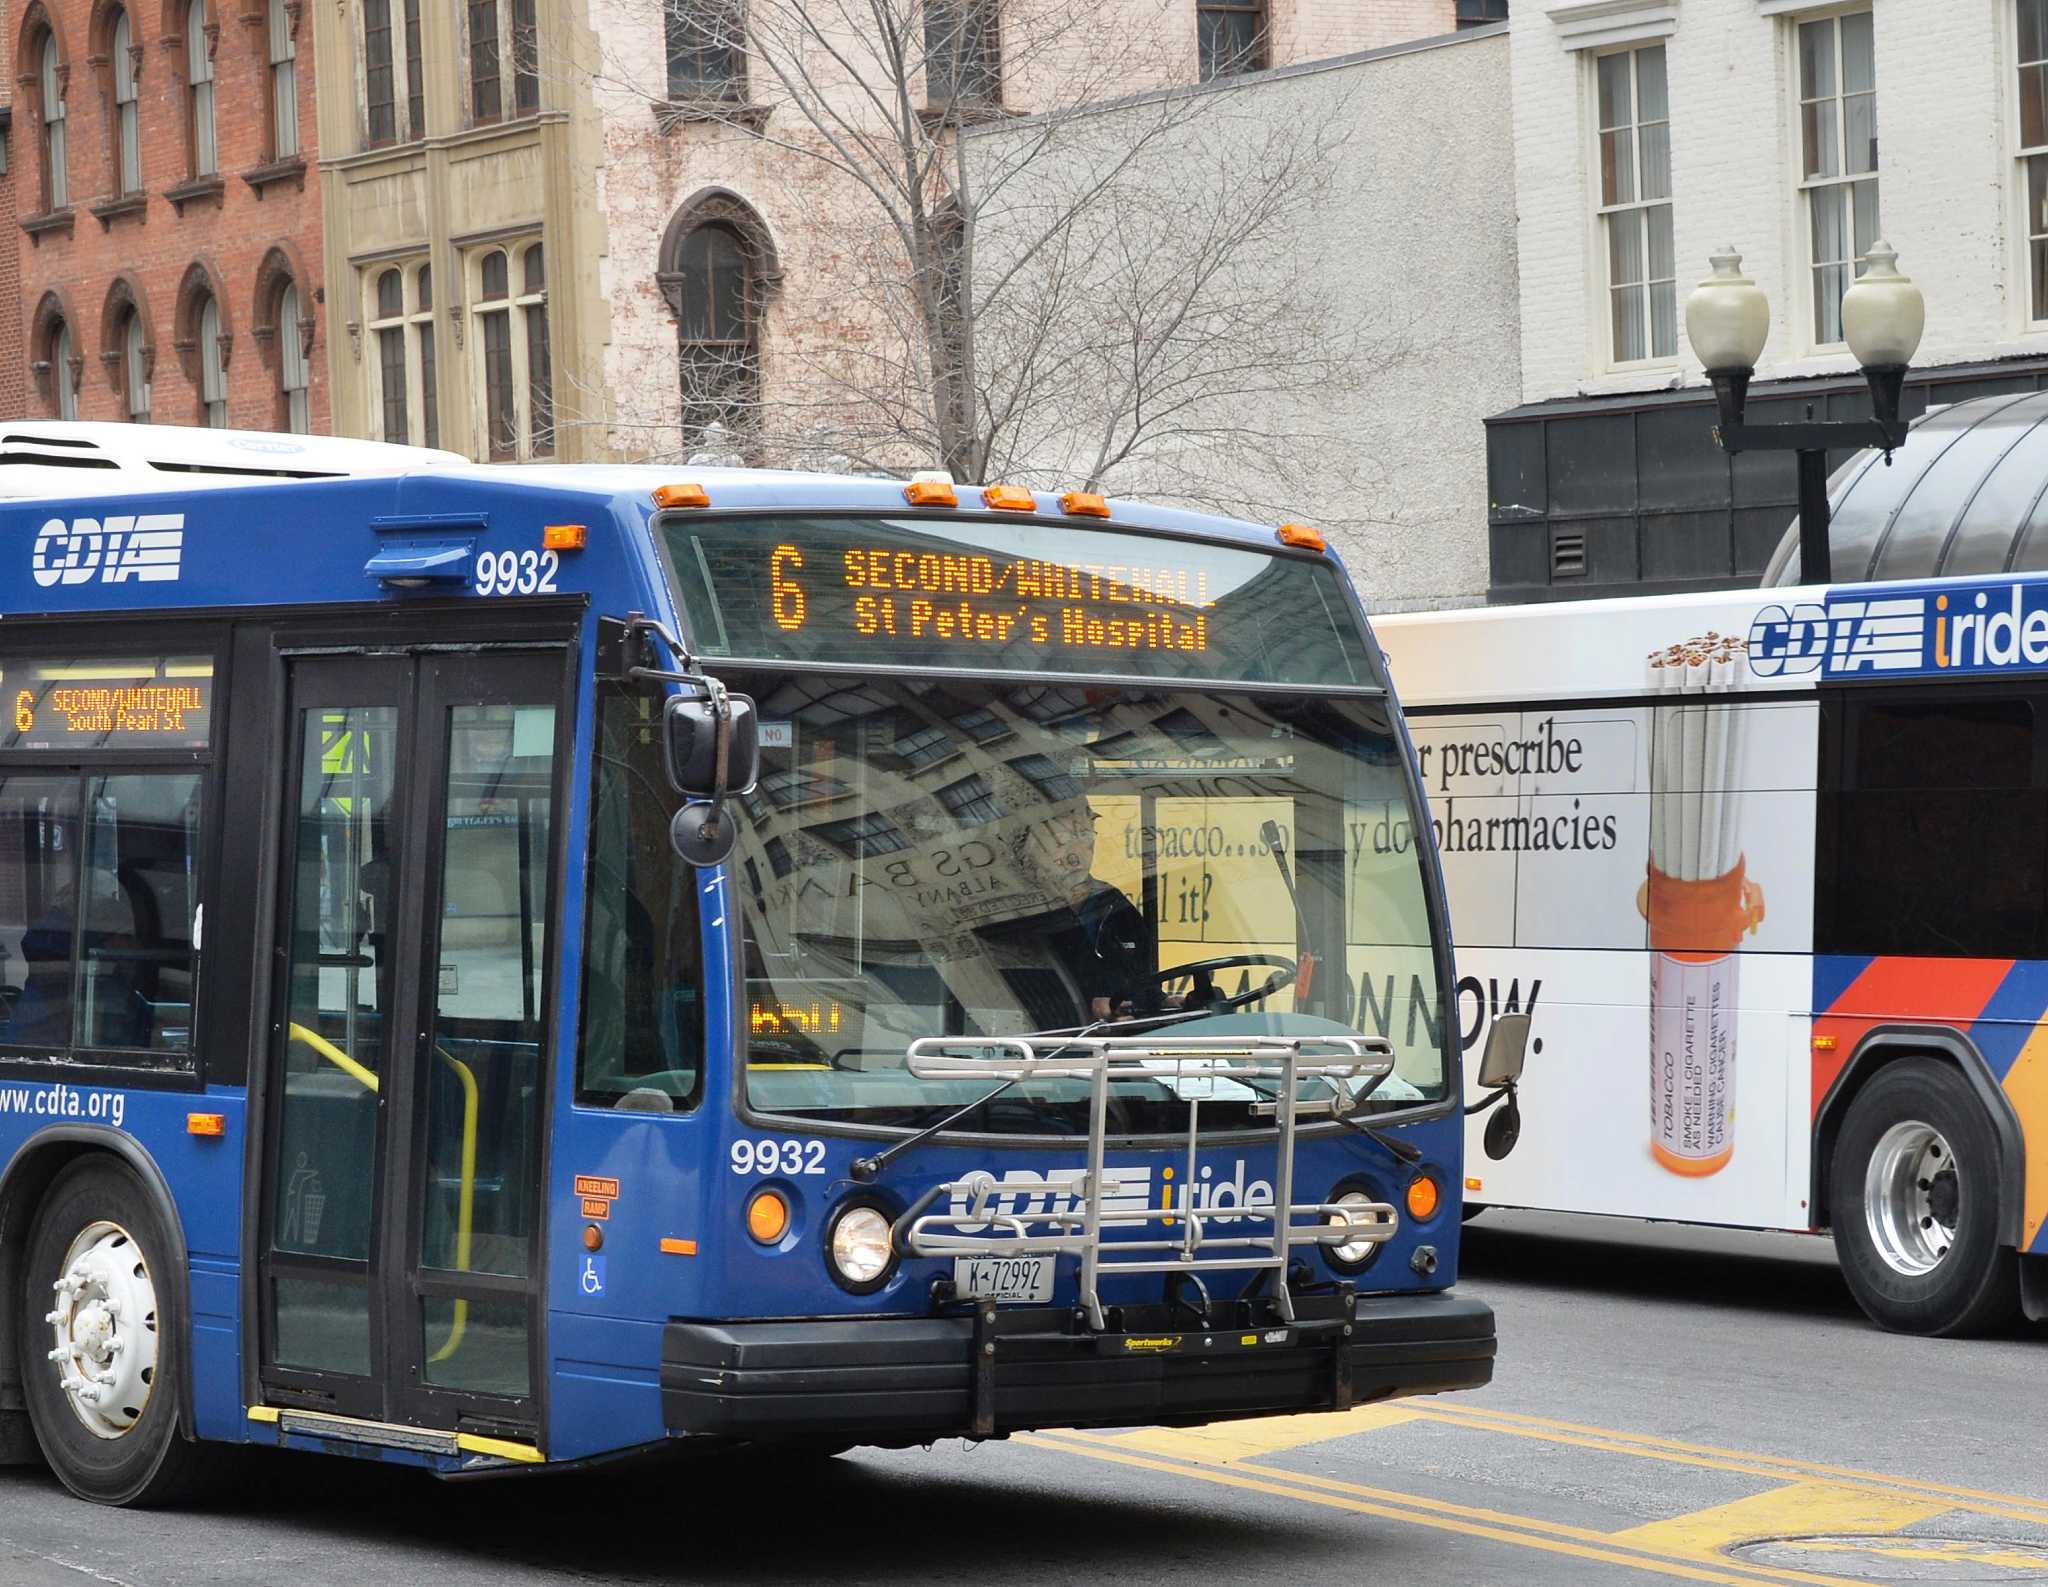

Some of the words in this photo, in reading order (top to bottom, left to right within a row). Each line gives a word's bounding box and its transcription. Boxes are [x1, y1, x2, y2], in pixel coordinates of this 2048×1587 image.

[33, 514, 184, 587] CDTA
[475, 550, 560, 596] 9932
[843, 549, 1216, 608] SECOND/WHITEHALL
[771, 544, 804, 631] 6
[855, 597, 897, 636] St
[912, 600, 1049, 643] Peter's
[1062, 608, 1207, 652] Hospital
[1750, 599, 1925, 677] CDTA
[15, 689, 34, 732] 6
[53, 687, 203, 712] SECOND/WHITEHALL
[66, 710, 113, 732] South
[116, 709, 159, 731] Pearl
[1440, 717, 1582, 791] prescribe
[1684, 995, 1696, 1080] CIGARETTE
[1664, 1051, 1674, 1140] TOBACCO
[1683, 1096, 1693, 1149] SMOKE
[1693, 1065, 1702, 1127] NEEDED
[731, 1139, 826, 1175] 9932
[1692, 1130, 1701, 1149] AS
[1162, 1157, 1275, 1227] iride
